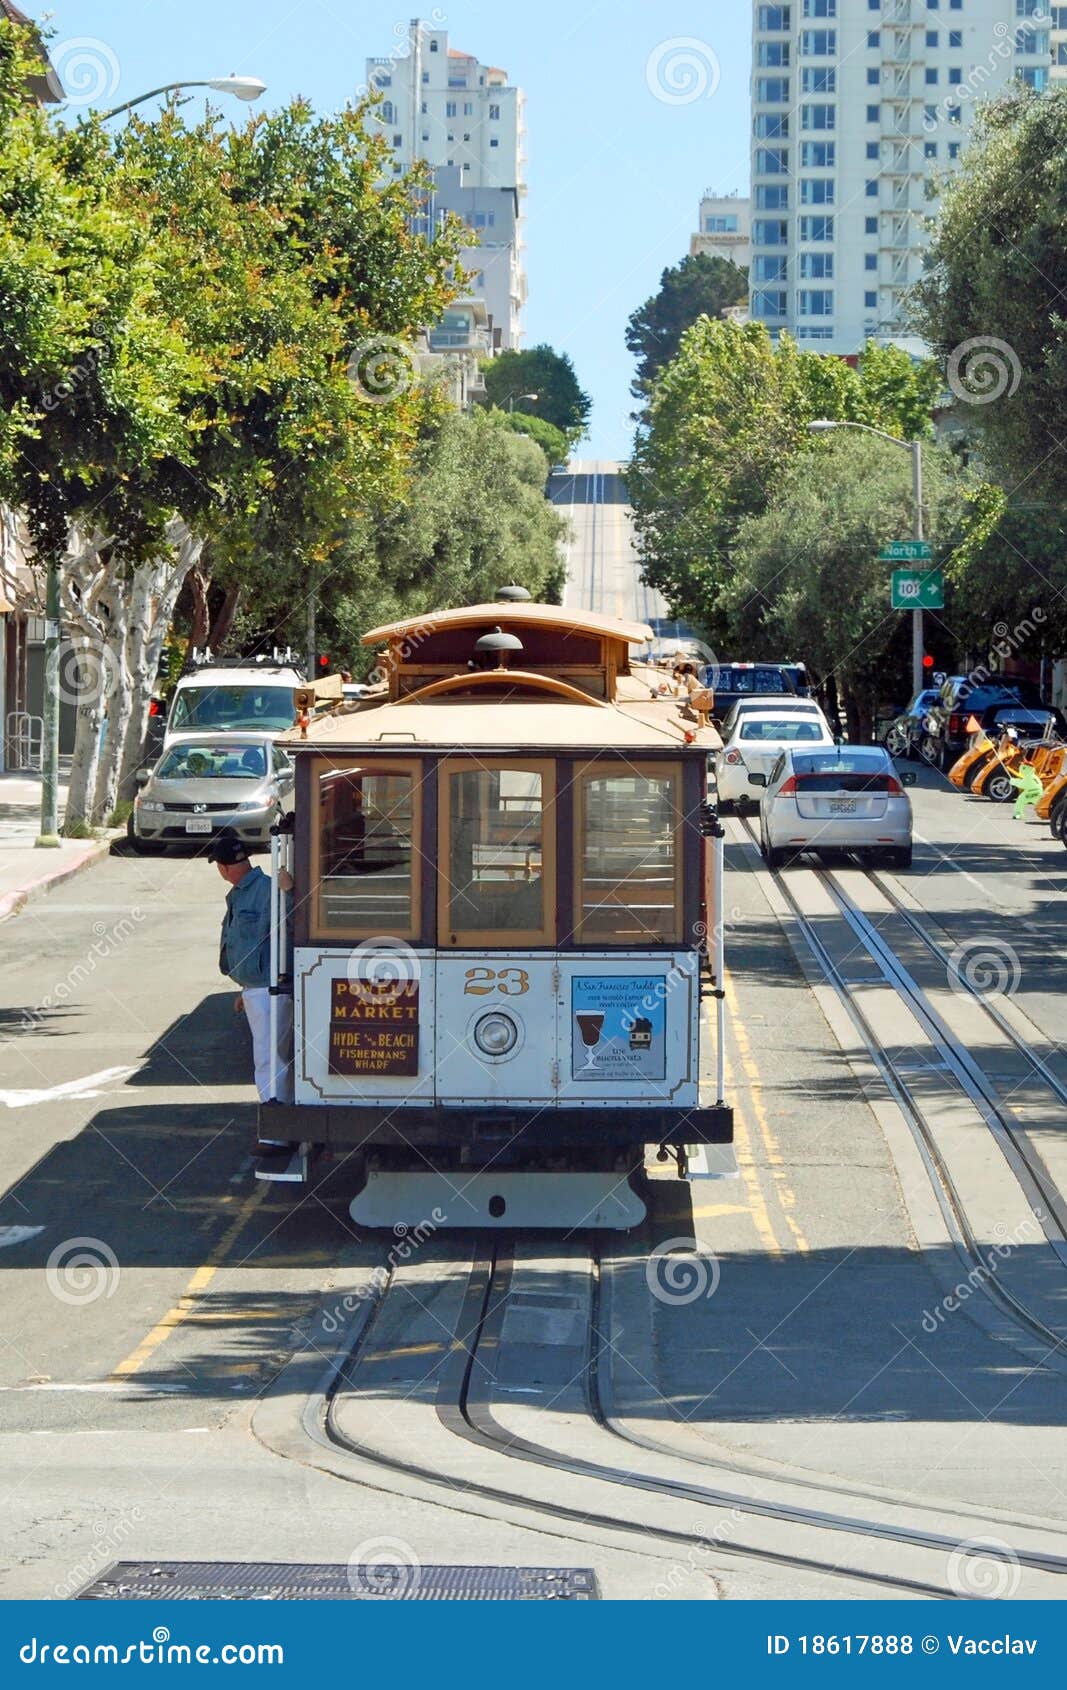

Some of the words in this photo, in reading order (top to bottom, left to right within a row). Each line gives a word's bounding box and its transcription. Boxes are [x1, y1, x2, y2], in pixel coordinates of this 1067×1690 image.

[901, 584, 918, 594] 101
[464, 967, 529, 996] 23
[336, 983, 415, 997] POWELL
[335, 1006, 417, 1018] MARKET
[333, 1032, 361, 1046] HYDE
[378, 1033, 414, 1048] BEACH
[340, 1049, 407, 1060] FISHERMANS
[355, 1060, 390, 1070] WHARF
